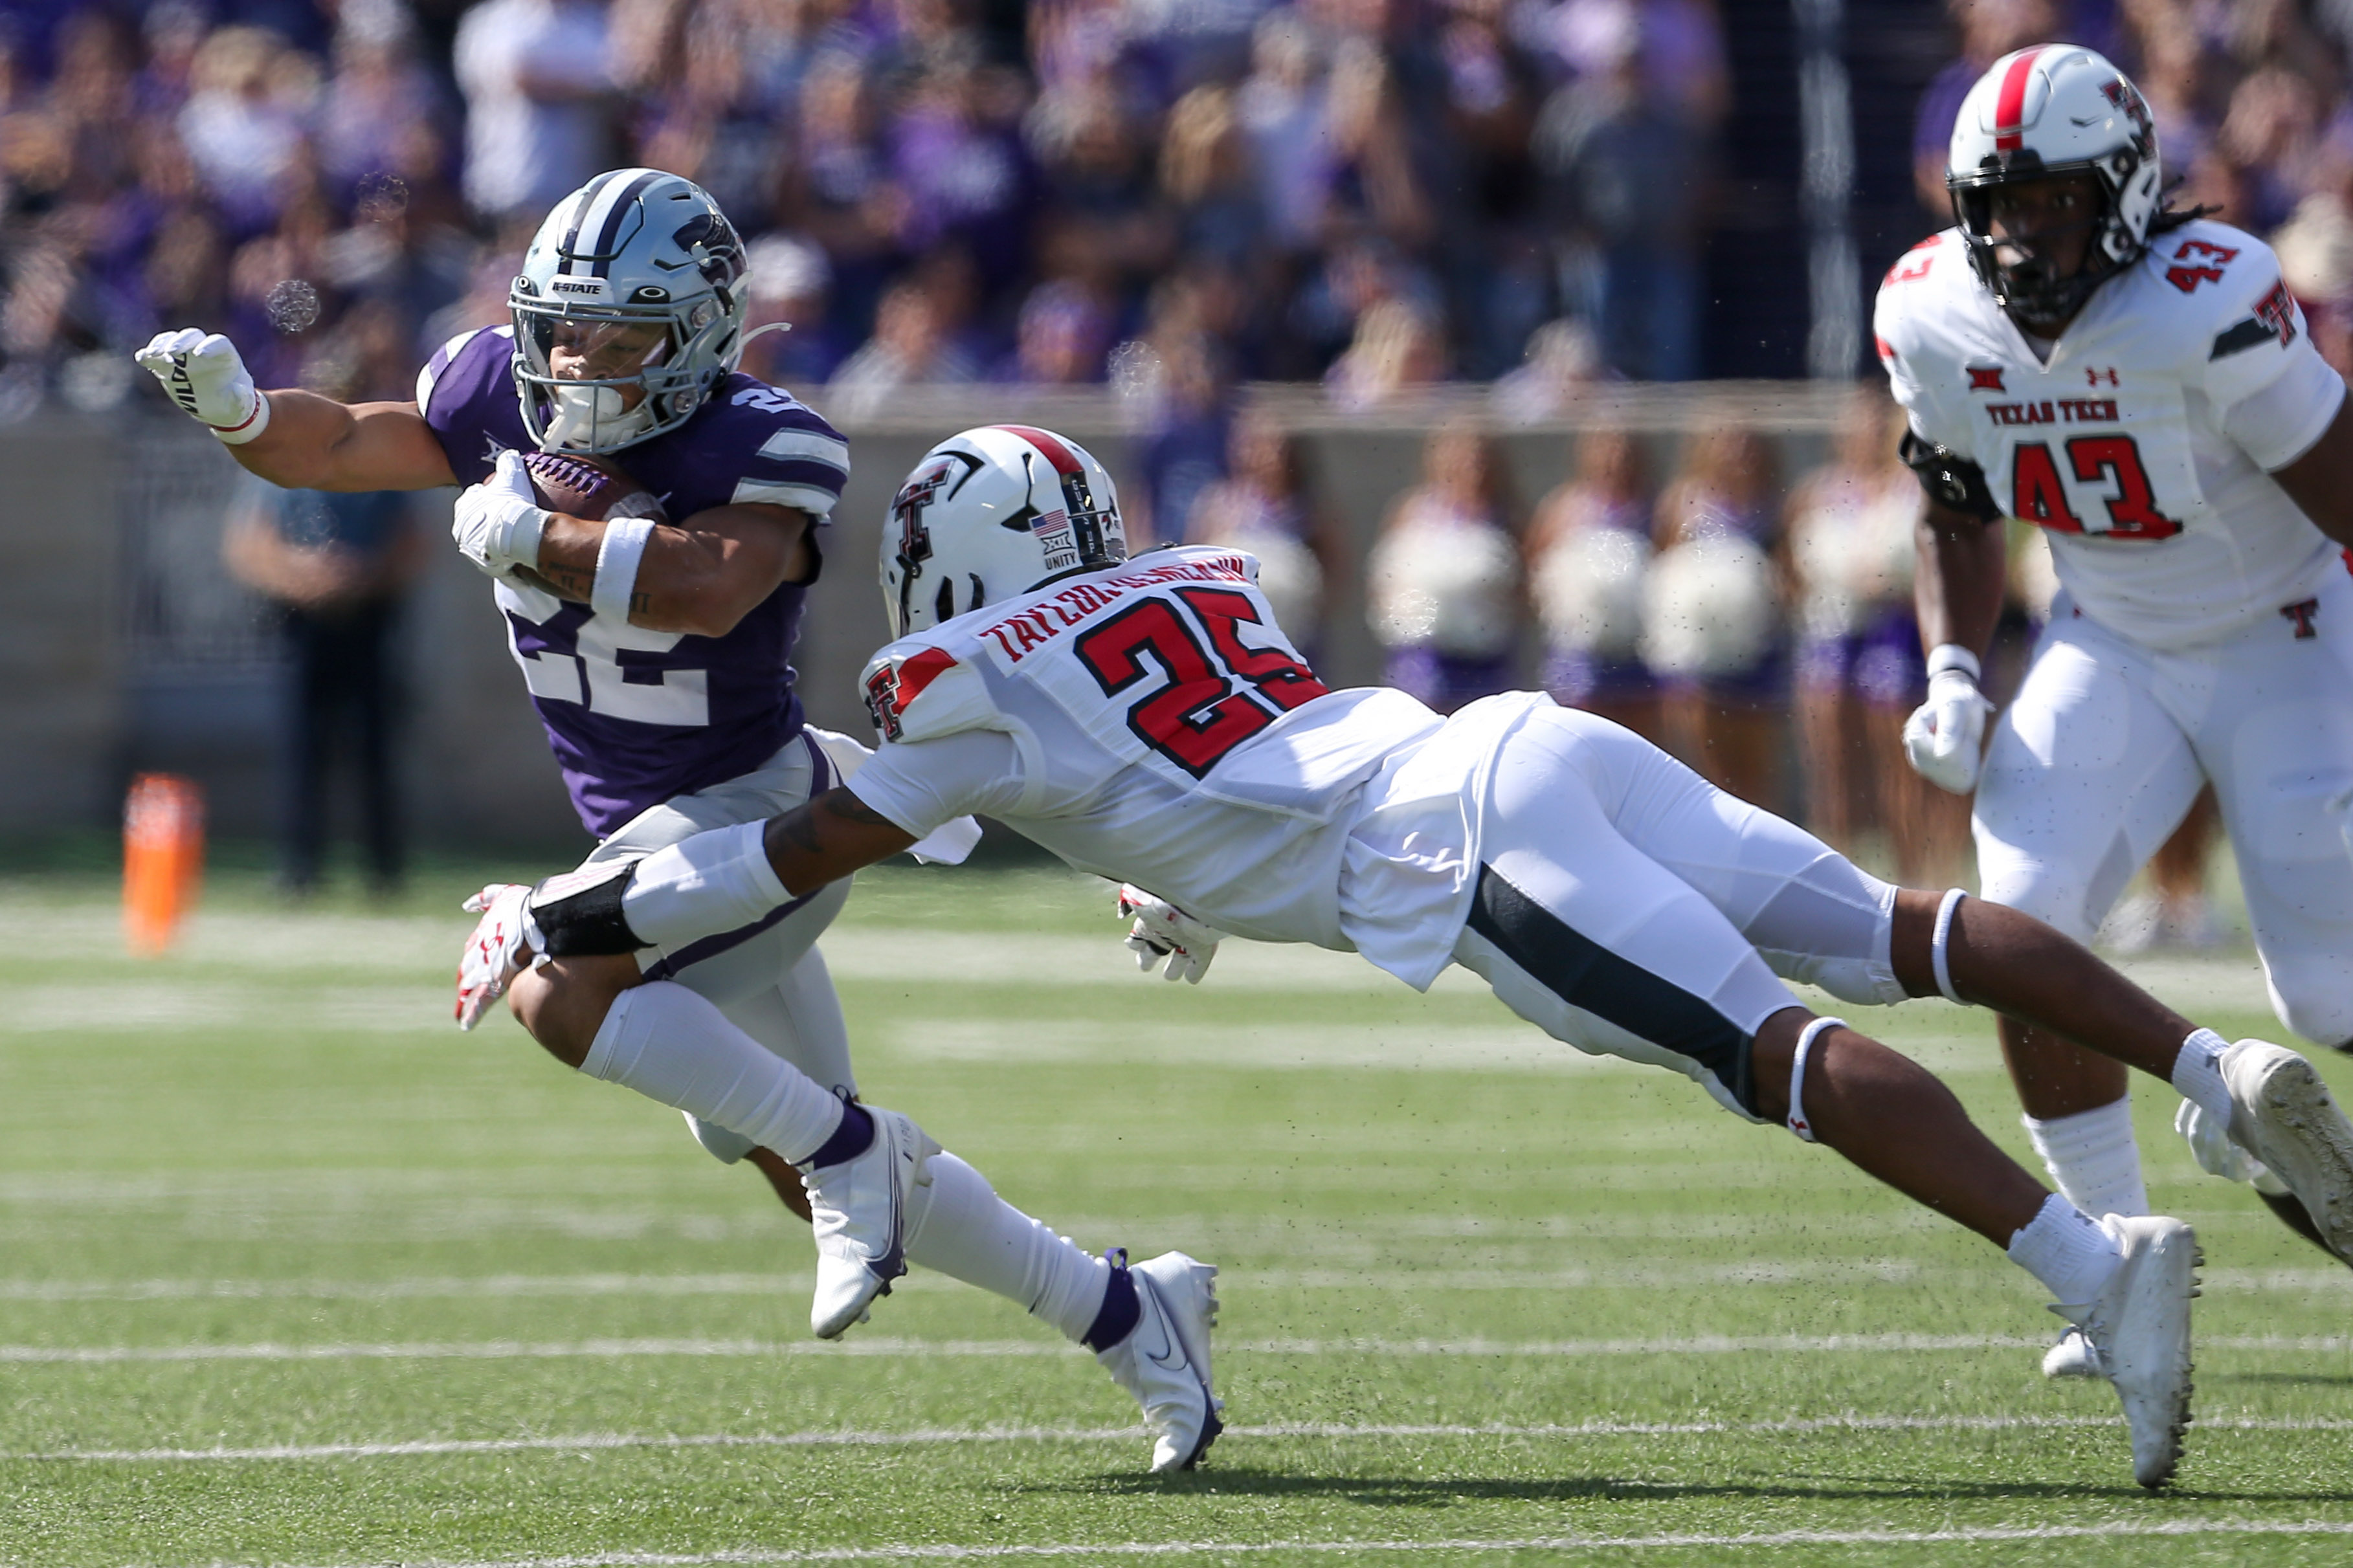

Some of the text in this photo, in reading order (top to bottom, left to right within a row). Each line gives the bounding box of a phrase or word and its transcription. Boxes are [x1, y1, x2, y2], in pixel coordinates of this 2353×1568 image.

[2165, 241, 2240, 294] 43
[552, 282, 603, 294] K-STATE
[1985, 399, 2120, 426] TEXAS TECH
[2012, 436, 2184, 540] 43
[1045, 551, 1076, 570] UNITY
[1073, 585, 1332, 782] 25
